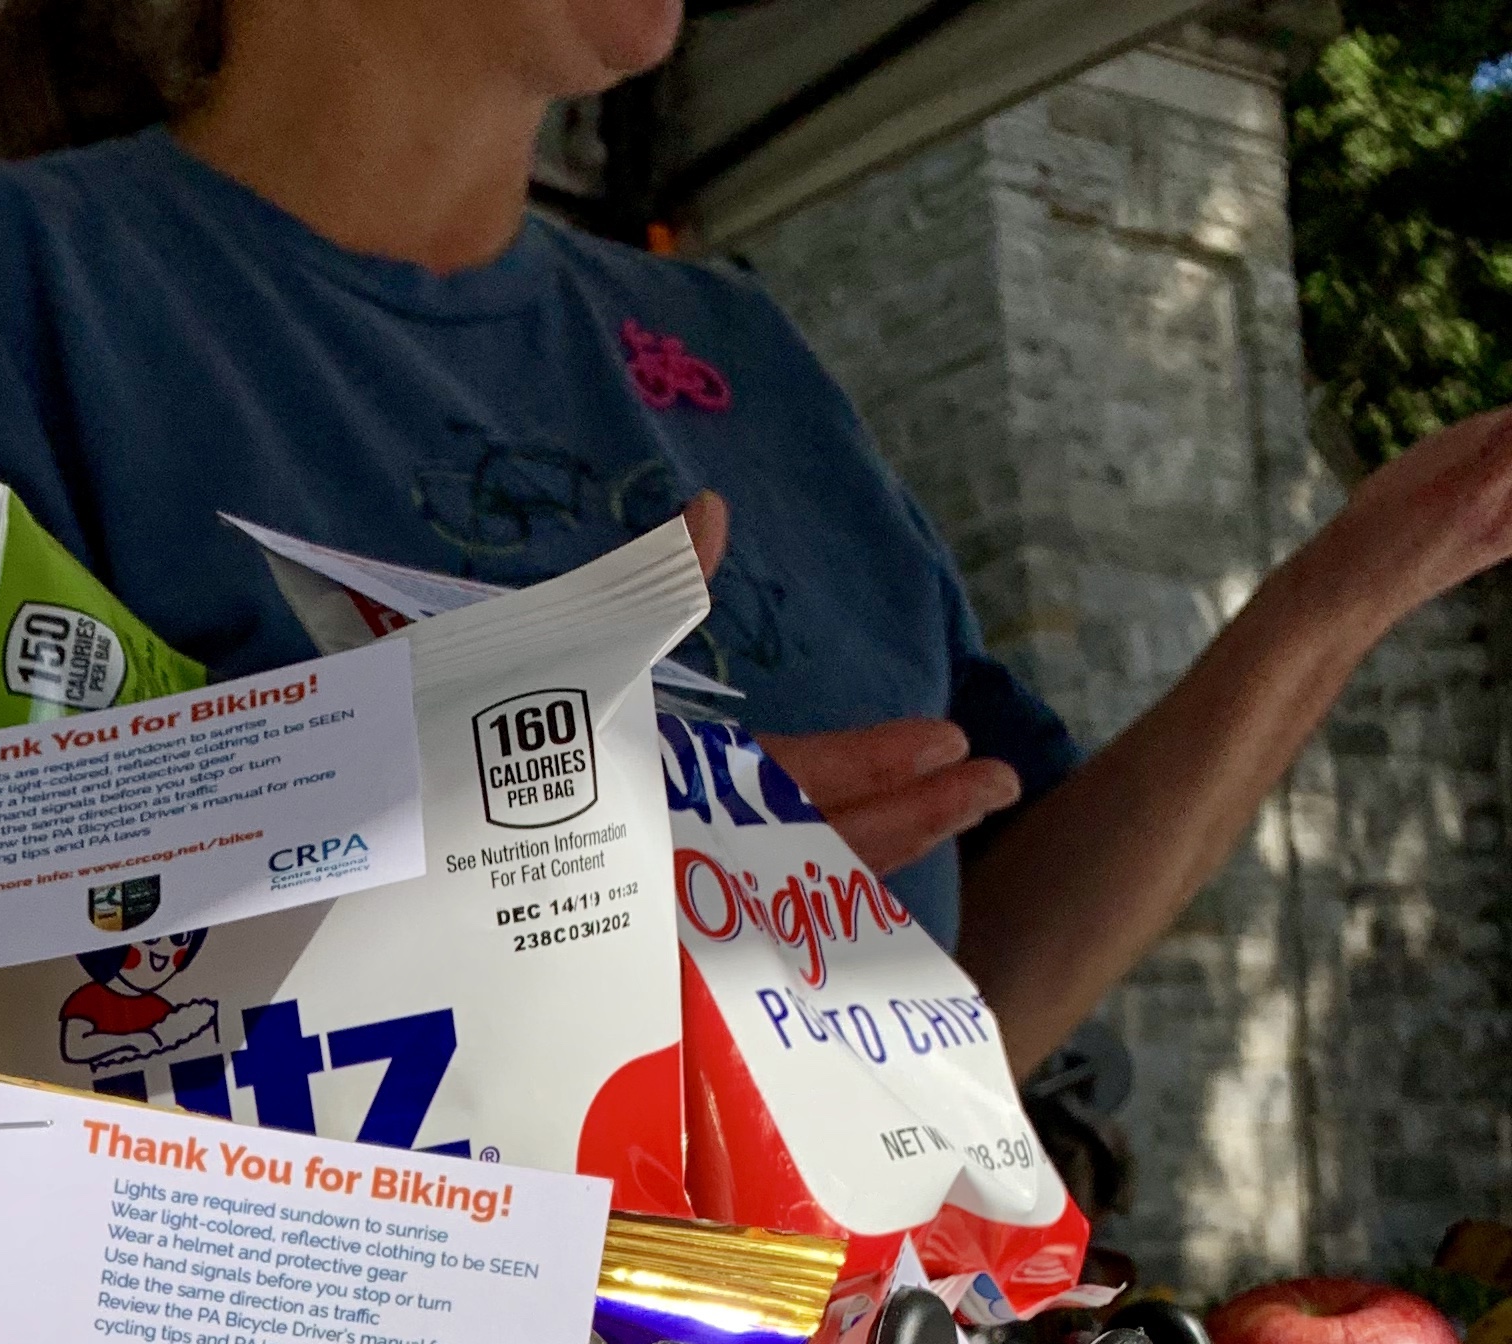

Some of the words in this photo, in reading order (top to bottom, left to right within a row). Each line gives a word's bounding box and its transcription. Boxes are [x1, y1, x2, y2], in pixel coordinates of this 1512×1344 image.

[18, 613, 71, 683] 150
[66, 618, 96, 701] CALORIES
[50, 724, 119, 751] You
[127, 710, 181, 737] for
[189, 672, 318, 723] Biking!
[490, 700, 576, 757] 160
[489, 749, 586, 789] CALORIES
[507, 789, 539, 808] PER
[544, 779, 575, 802] BAG
[267, 831, 369, 873] CRPA
[446, 853, 477, 874] See
[481, 838, 550, 866] Nutrition
[554, 822, 627, 853] Information
[490, 869, 516, 889] For
[521, 861, 546, 881] Fat
[551, 852, 606, 878] Content
[496, 903, 541, 926] DEC
[608, 881, 639, 901] 01:32
[82, 1118, 209, 1173] Thank
[218, 1141, 293, 1186] You
[303, 1154, 363, 1195] for
[369, 1165, 513, 1223] Biking!
[881, 1128, 926, 1161] NET
[112, 1177, 167, 1202] Lights
[169, 1189, 199, 1207] are
[201, 1194, 277, 1219] required
[278, 1206, 361, 1231] sundown
[363, 1216, 383, 1234] to
[384, 1222, 449, 1244] sunrise
[110, 1199, 158, 1223] Wear
[159, 1207, 276, 1243] light-colored,
[279, 1228, 362, 1255] reflective
[364, 1240, 437, 1268] clothing
[439, 1250, 459, 1268] to
[461, 1252, 486, 1272] be
[488, 1256, 540, 1279] SEEN
[103, 1245, 139, 1267] Use
[141, 1251, 188, 1274] hand
[189, 1260, 252, 1284] signals
[254, 1268, 313, 1293] before
[315, 1281, 348, 1298] you
[351, 1284, 391, 1307] stop
[393, 1292, 415, 1307] or
[416, 1292, 452, 1313] turn
[92, 1317, 157, 1342] cycling
[160, 1323, 192, 1344] tips
[96, 1290, 161, 1316] Review
[163, 1300, 193, 1321] the
[196, 1305, 221, 1326] PA
[223, 1309, 288, 1335] Bicycle
[290, 1319, 356, 1344] Driver's
